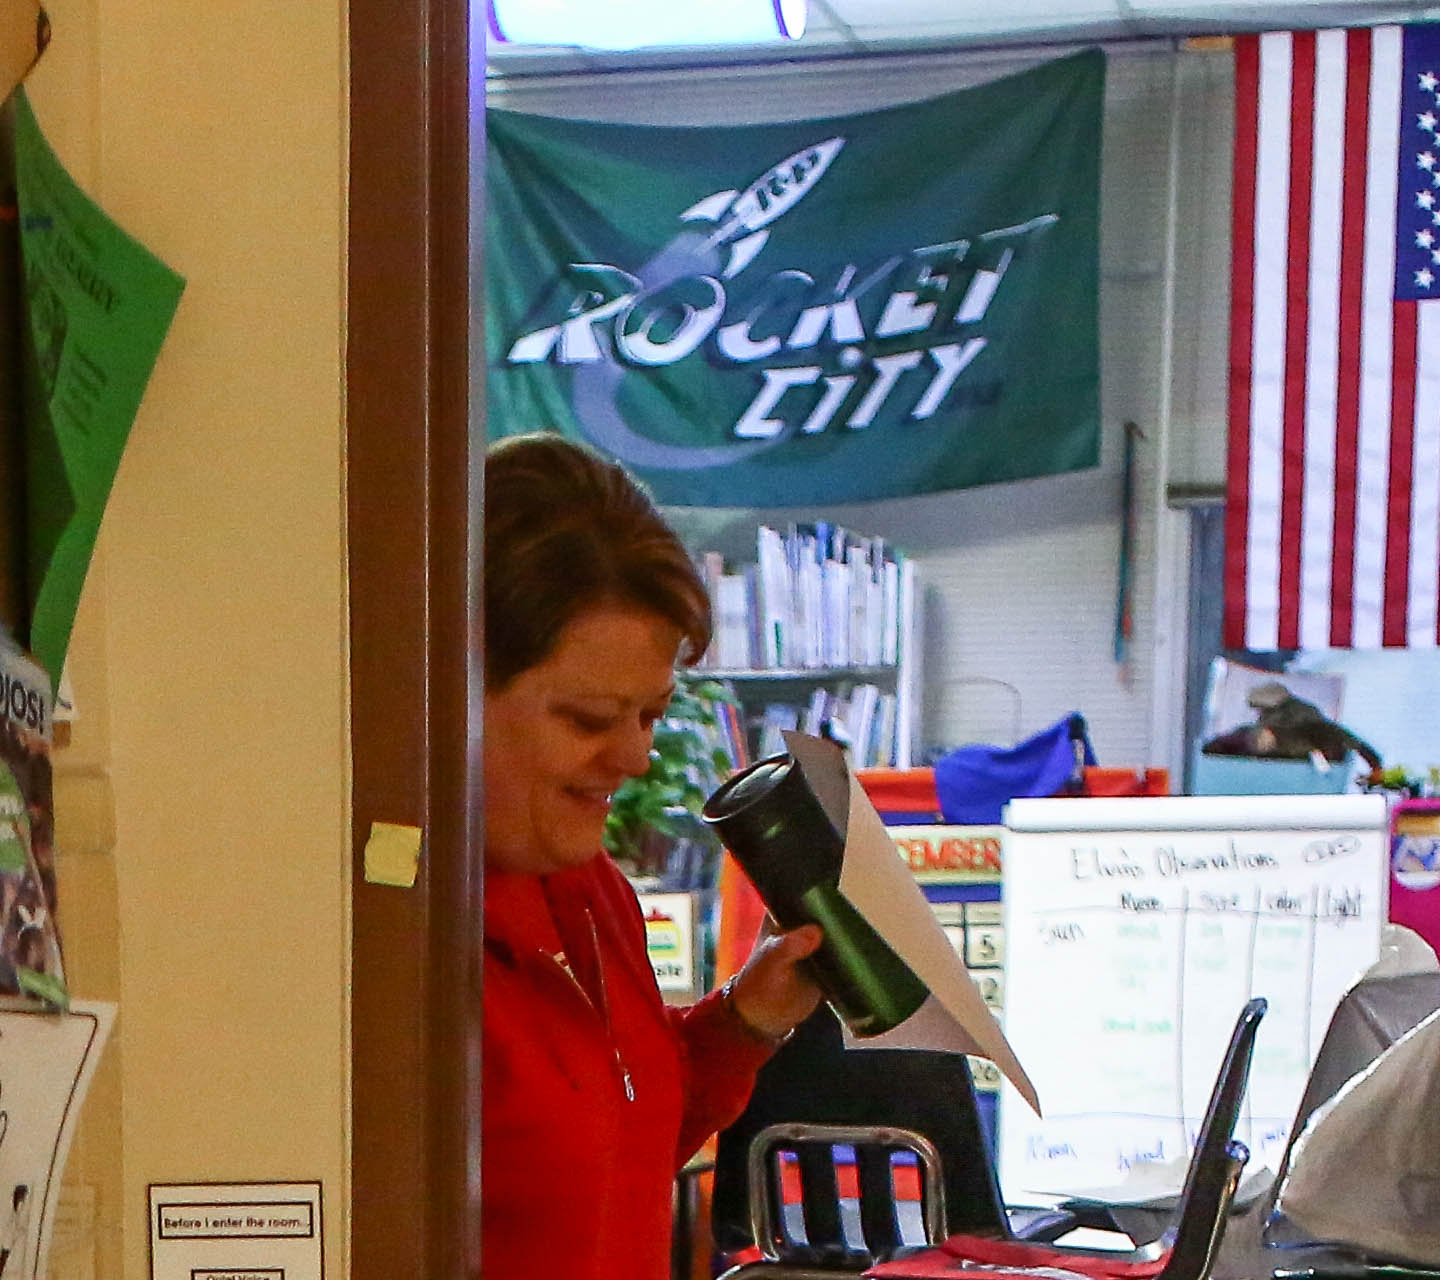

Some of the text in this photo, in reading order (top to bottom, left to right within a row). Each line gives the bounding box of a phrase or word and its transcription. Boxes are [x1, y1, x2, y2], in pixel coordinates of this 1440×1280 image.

[507, 212, 1060, 366] ROCKET
[163, 1217, 202, 1229] Before
[212, 1217, 243, 1228] enter
[247, 1217, 264, 1228] the
